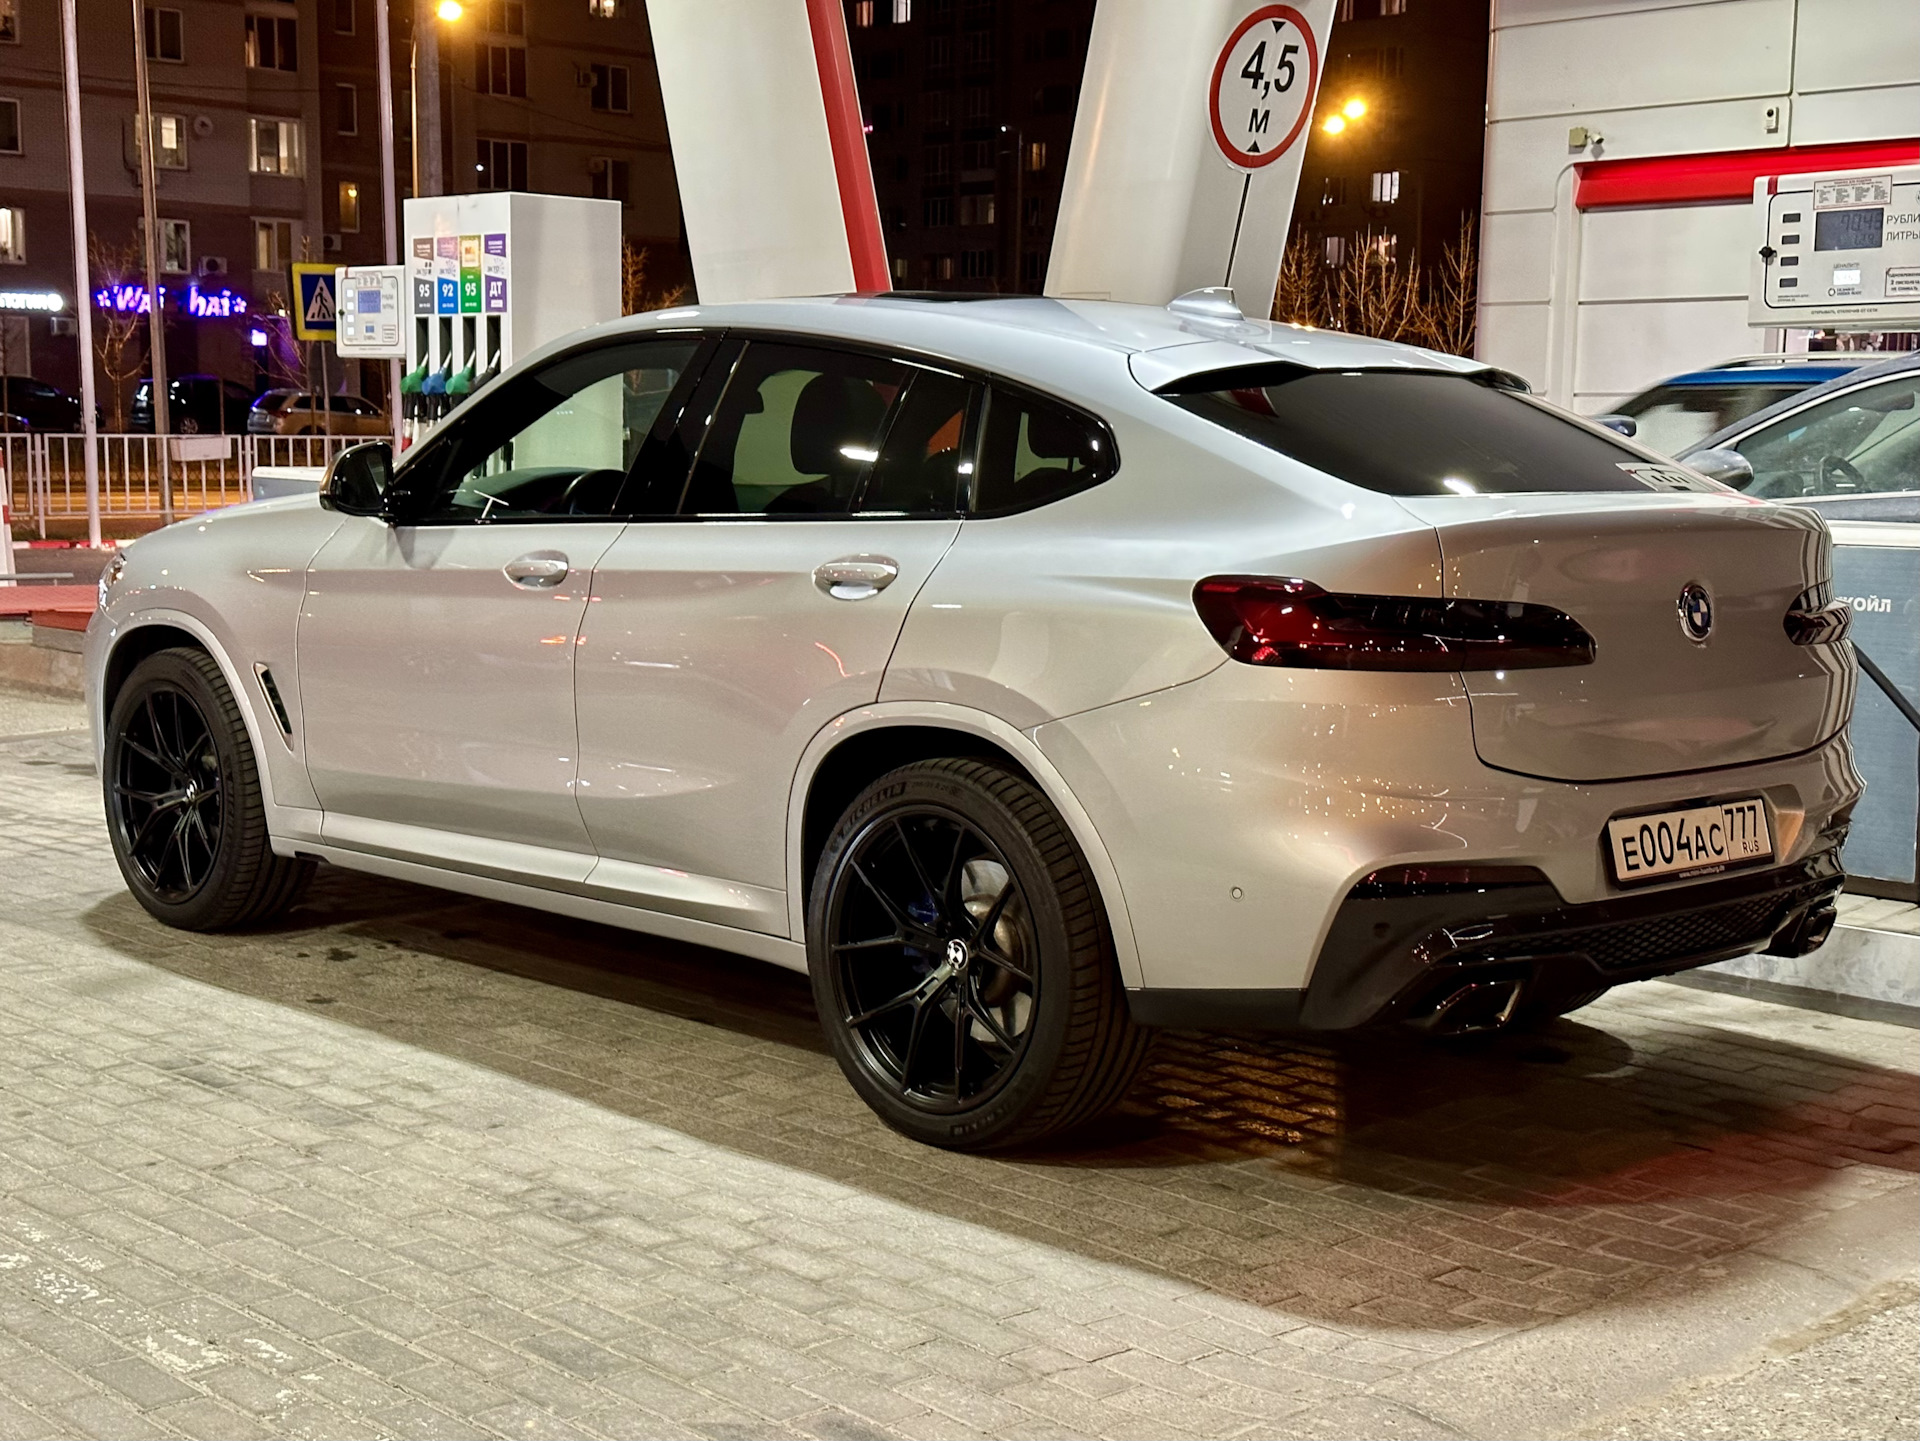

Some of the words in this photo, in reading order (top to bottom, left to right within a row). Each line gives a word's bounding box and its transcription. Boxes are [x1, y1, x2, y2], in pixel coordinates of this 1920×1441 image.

[1241, 41, 1299, 100] 4,5
[418, 283, 430, 298] 95
[442, 283, 454, 297] 92
[465, 282, 477, 296] 95
[489, 281, 502, 297] ДТ
[1724, 804, 1758, 842] 777
[1742, 840, 1760, 855] RUS
